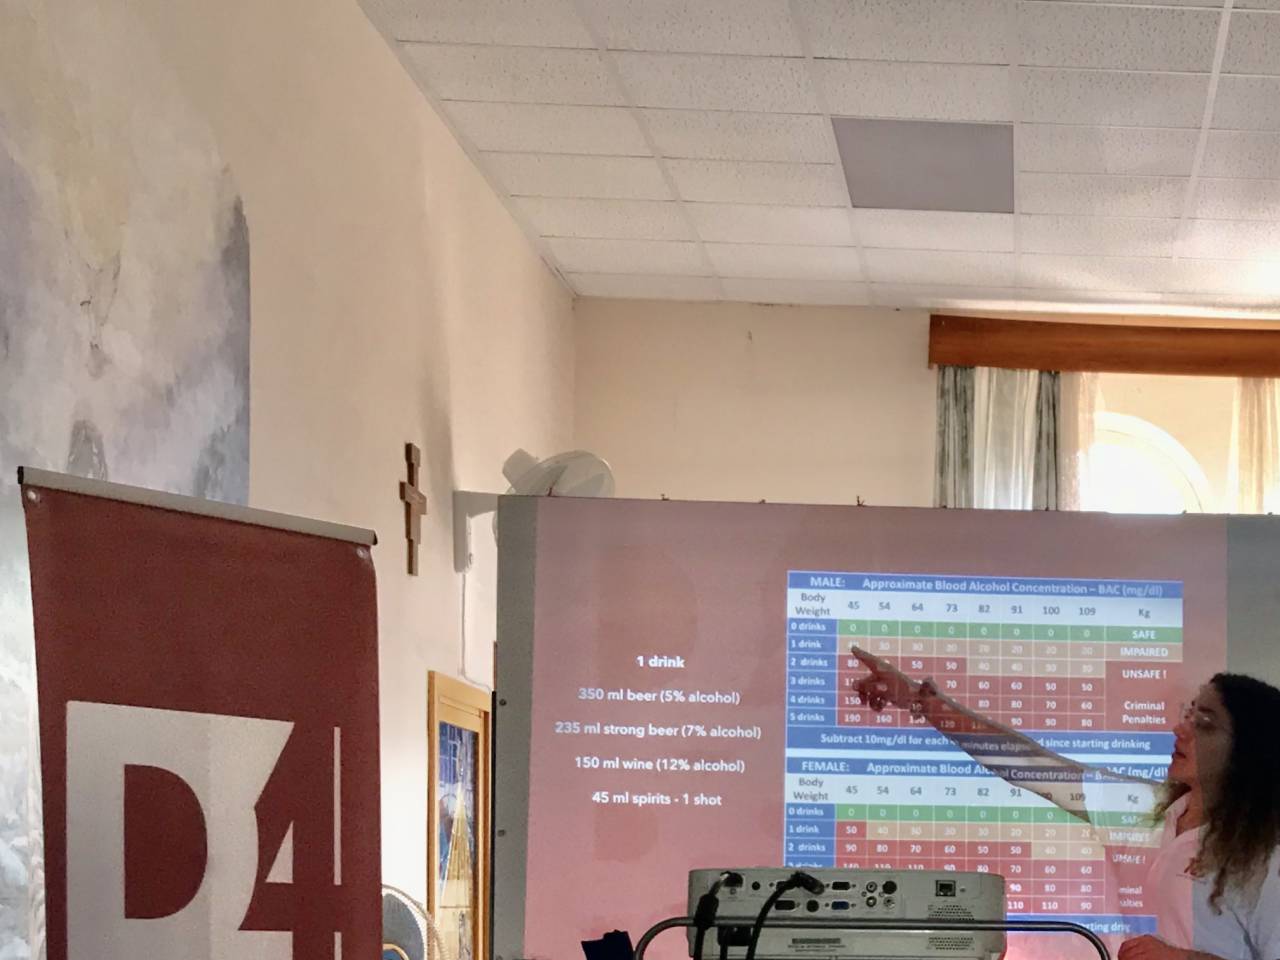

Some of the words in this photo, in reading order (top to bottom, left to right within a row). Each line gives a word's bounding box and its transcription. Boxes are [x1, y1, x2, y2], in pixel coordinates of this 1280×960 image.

[810, 577, 846, 587] MALE:
[862, 578, 933, 591] Approximate
[935, 580, 966, 591] Blood
[968, 581, 1010, 592] Alcohol
[1012, 582, 1088, 594] Concentration
[1098, 584, 1120, 595] BAC
[1122, 584, 1163, 597] (mg/dl)
[801, 592, 825, 604] Body
[795, 606, 831, 617] Weight
[848, 601, 860, 610] 45
[879, 602, 891, 611] 54
[912, 602, 924, 612] 64
[946, 603, 958, 613] 73
[978, 604, 990, 613] 82
[1011, 605, 1023, 614] 91
[1043, 606, 1060, 615] 100
[1079, 607, 1096, 616] 109
[1138, 608, 1151, 619] Kg
[791, 621, 797, 630] 0
[798, 621, 826, 631] drinks
[1132, 630, 1157, 640] SAFE
[790, 639, 797, 648] 1
[798, 639, 821, 649] drink
[1120, 647, 1169, 657] IMPAIRED
[637, 655, 644, 667] 1
[649, 655, 685, 669] drink
[790, 657, 796, 666] 2
[800, 657, 828, 667] drinks
[912, 660, 923, 670] 50
[946, 661, 958, 671] 50
[1122, 669, 1161, 679] UNSAFE
[790, 676, 796, 685] 3
[798, 676, 825, 686] drinks
[946, 680, 957, 689] 70
[1011, 681, 1023, 690] 60
[578, 687, 604, 700] 350
[607, 688, 624, 701] ml
[627, 689, 657, 702] beer
[660, 690, 685, 704] (5%
[688, 691, 741, 705] alcohol)
[790, 696, 796, 705] 4
[798, 696, 825, 705] drinks
[845, 696, 861, 705] 150
[1045, 701, 1057, 710] 70
[1081, 701, 1093, 710] 60
[1124, 701, 1165, 711] Criminal
[790, 712, 796, 721] 5
[798, 712, 825, 722] drinks
[876, 714, 892, 724] 160
[1122, 714, 1167, 724] Penalties
[555, 721, 581, 734] 235
[584, 722, 600, 735] ml
[604, 724, 645, 738] strong
[648, 724, 679, 737] beer
[681, 724, 707, 739] (7%
[710, 725, 762, 740] alcohol)
[820, 733, 863, 744] Subtract
[865, 734, 907, 746] 10mg/dl
[909, 735, 923, 745] for
[925, 736, 949, 746] each
[1045, 738, 1070, 747] since
[1072, 738, 1110, 750] starting
[1111, 739, 1151, 751] drinking
[575, 756, 600, 769] 150
[603, 757, 620, 769] ml
[622, 757, 653, 770] wine
[656, 758, 690, 773] (12%
[693, 759, 745, 774] alcohol)
[802, 760, 850, 772] FEMALE:
[866, 762, 937, 774] Approximate
[940, 764, 971, 775] Blood
[1011, 769, 1083, 780] Concentration
[799, 777, 824, 788] Body
[793, 791, 829, 802] Weight
[846, 785, 858, 795] 45
[877, 786, 889, 796] 54
[910, 786, 922, 796] 64
[944, 787, 957, 796] 73
[977, 787, 989, 797] 82
[1010, 788, 1022, 797] 91
[591, 791, 609, 804] 45
[612, 791, 629, 804] ml
[632, 792, 671, 807] spirits
[682, 794, 689, 805] 1
[693, 793, 722, 806] shot
[788, 807, 795, 815] 0
[796, 807, 824, 817] drinks
[789, 825, 794, 833] 1
[796, 824, 819, 834] drink
[846, 825, 857, 834] 50
[787, 843, 794, 851] 2
[798, 843, 826, 852] drinks
[845, 844, 857, 853] 90
[910, 844, 922, 853] 70
[1010, 846, 1022, 855] 50
[1010, 865, 1021, 873] 70
[1081, 866, 1092, 874] 60
[1007, 901, 1024, 910] 110
[1042, 902, 1058, 910] 110
